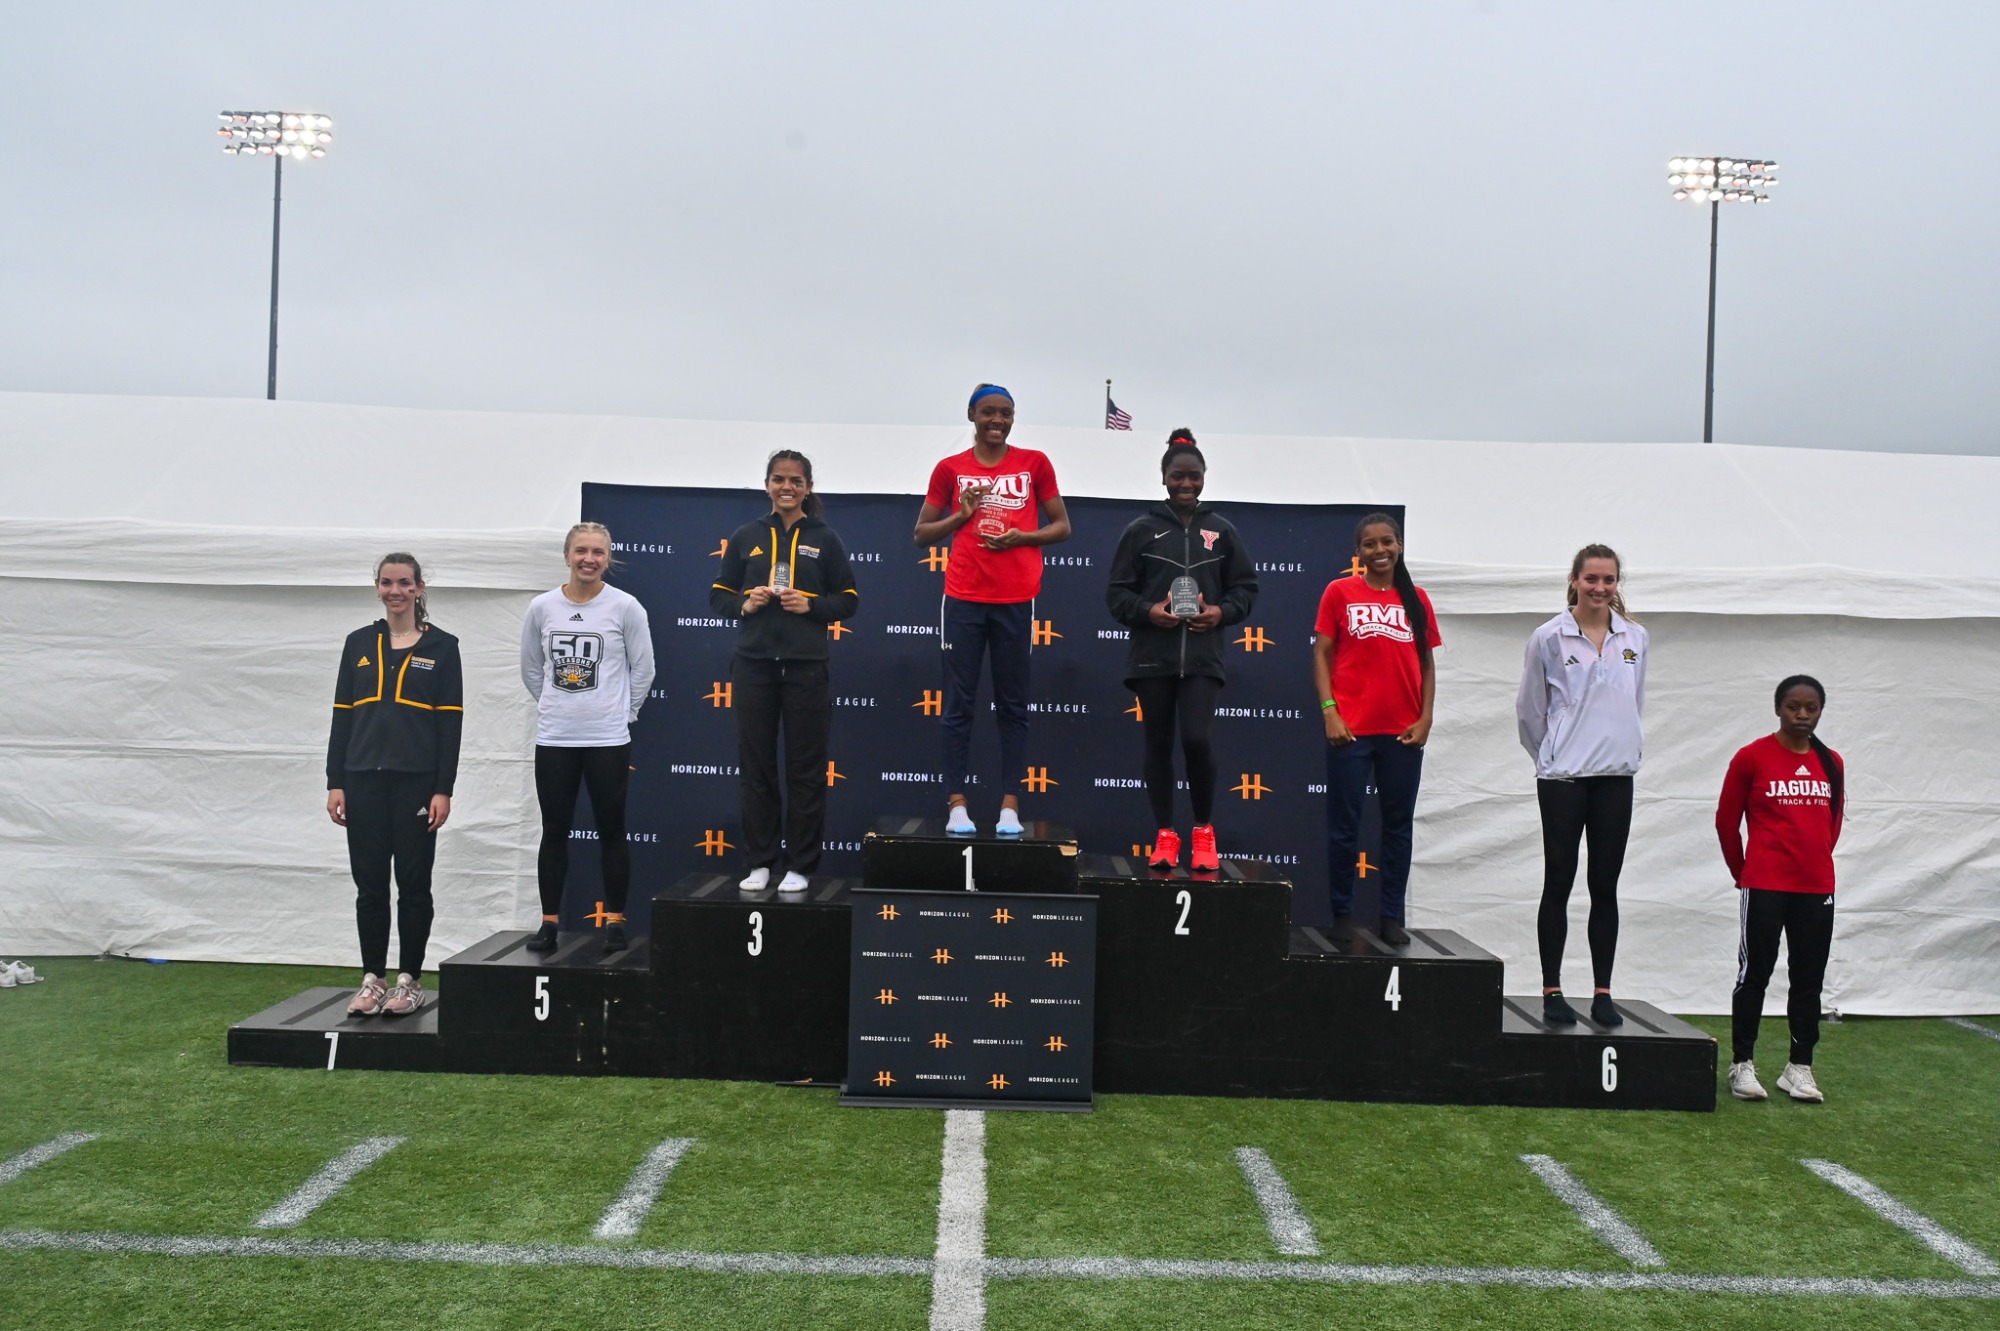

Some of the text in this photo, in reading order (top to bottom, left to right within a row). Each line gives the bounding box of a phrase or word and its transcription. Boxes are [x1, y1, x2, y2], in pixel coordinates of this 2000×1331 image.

[1200, 529, 1220, 550] Y
[677, 617, 724, 628] HORIZON
[886, 624, 934, 635] HORIZON
[1097, 629, 1130, 640] HORIZ
[1389, 629, 1408, 638] FIELD
[551, 633, 601, 659] 50
[556, 656, 592, 667] SEASONS
[1215, 707, 1251, 718] RIZON
[670, 764, 740, 776] HORIZON LEA
[881, 771, 929, 782] HORIZON
[1094, 777, 1142, 788] HORIZON
[567, 829, 600, 840] ORIZO
[822, 841, 861, 852] LEAGU
[961, 846, 975, 891] 1
[1174, 890, 1192, 936] 2
[748, 911, 763, 957] 3
[862, 950, 887, 958] HORIZON
[1384, 966, 1402, 1012] 4
[534, 975, 550, 1021] 5
[324, 1031, 339, 1070] 7
[1601, 1047, 1617, 1092] 6
